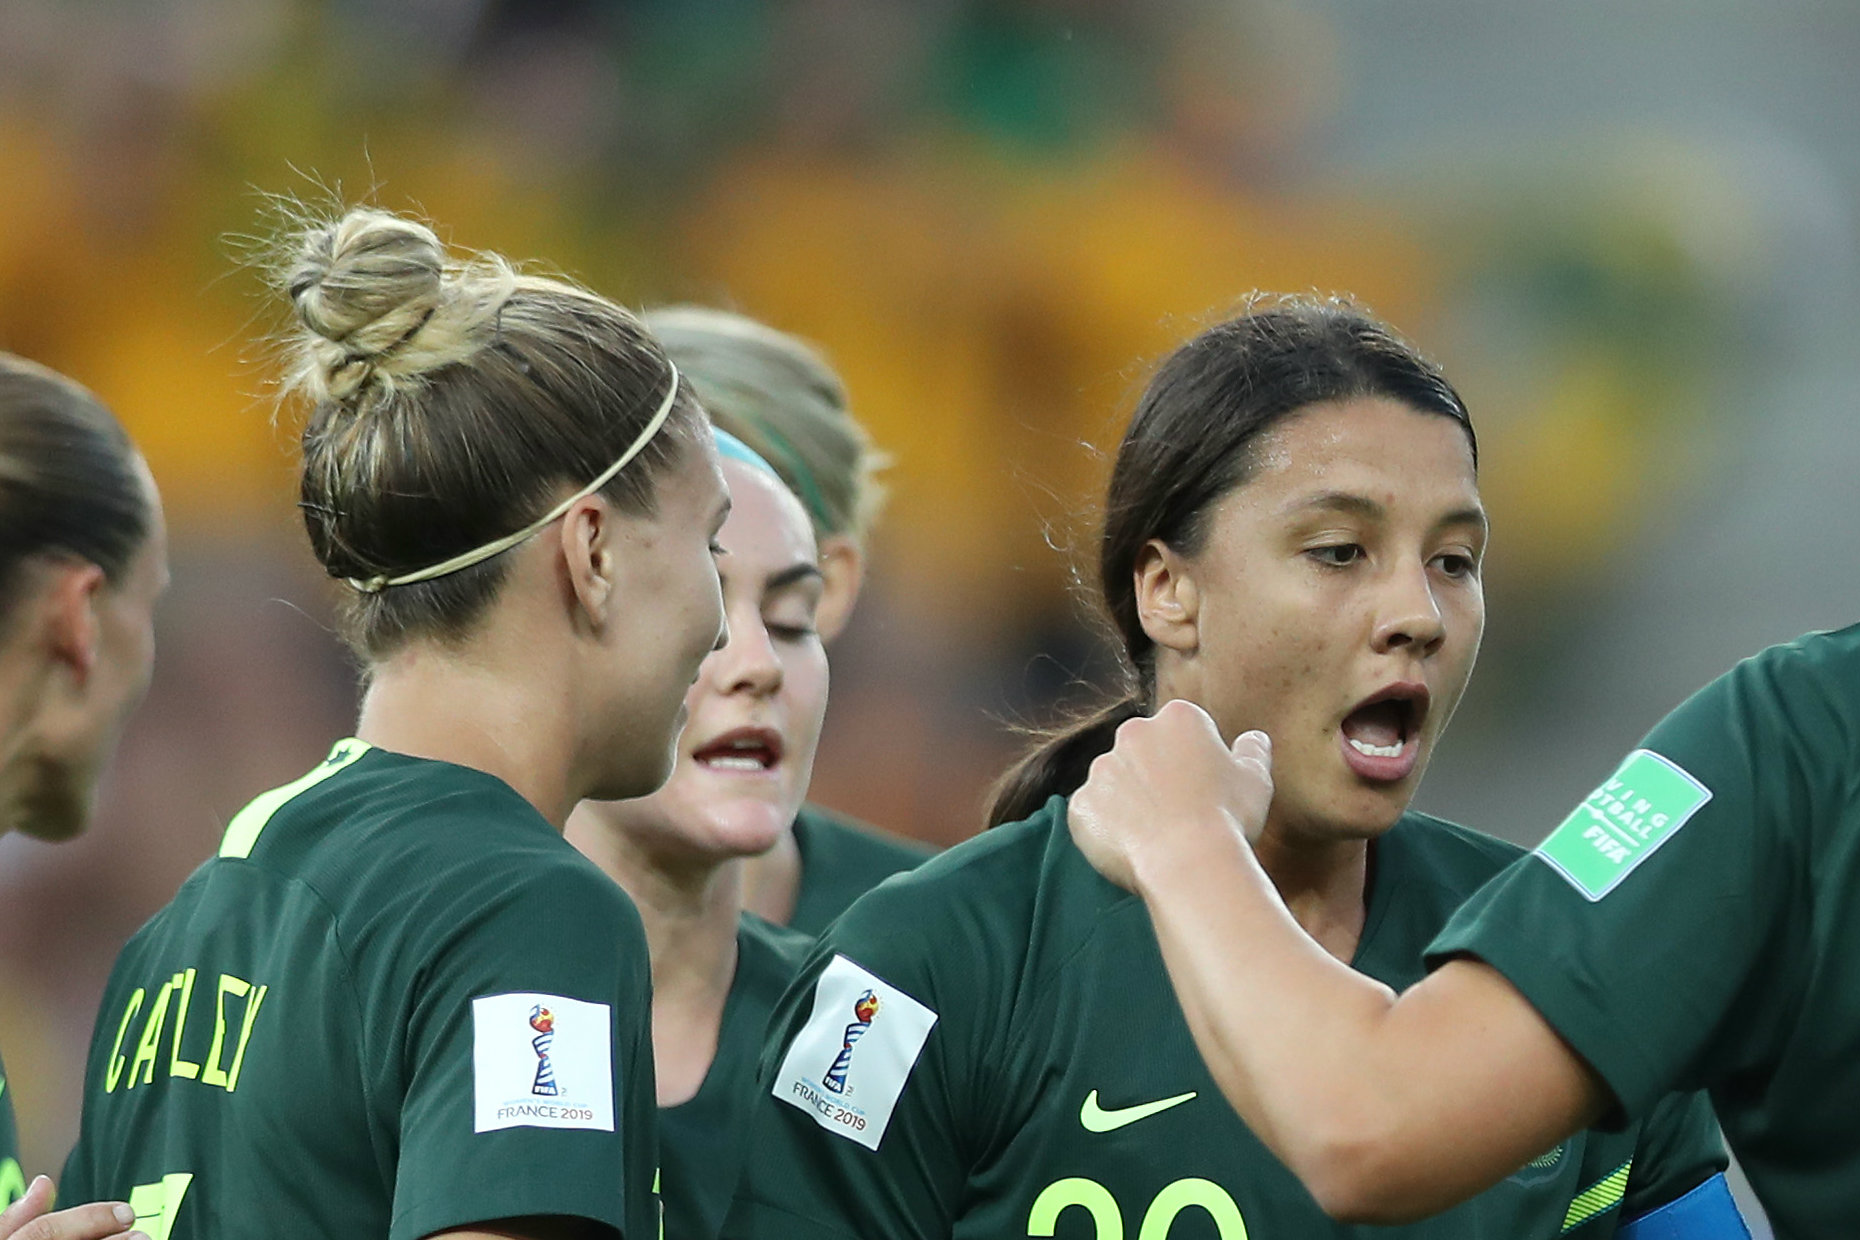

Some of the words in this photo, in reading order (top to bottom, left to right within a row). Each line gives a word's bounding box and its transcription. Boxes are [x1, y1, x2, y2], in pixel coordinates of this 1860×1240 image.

[1605, 778, 1669, 828] VING
[1582, 825, 1632, 864] FIFA
[497, 1105, 558, 1120] FRANCE
[560, 1107, 593, 1121] 2019
[792, 1081, 835, 1118] FRANCE
[834, 1109, 867, 1131] 2019
